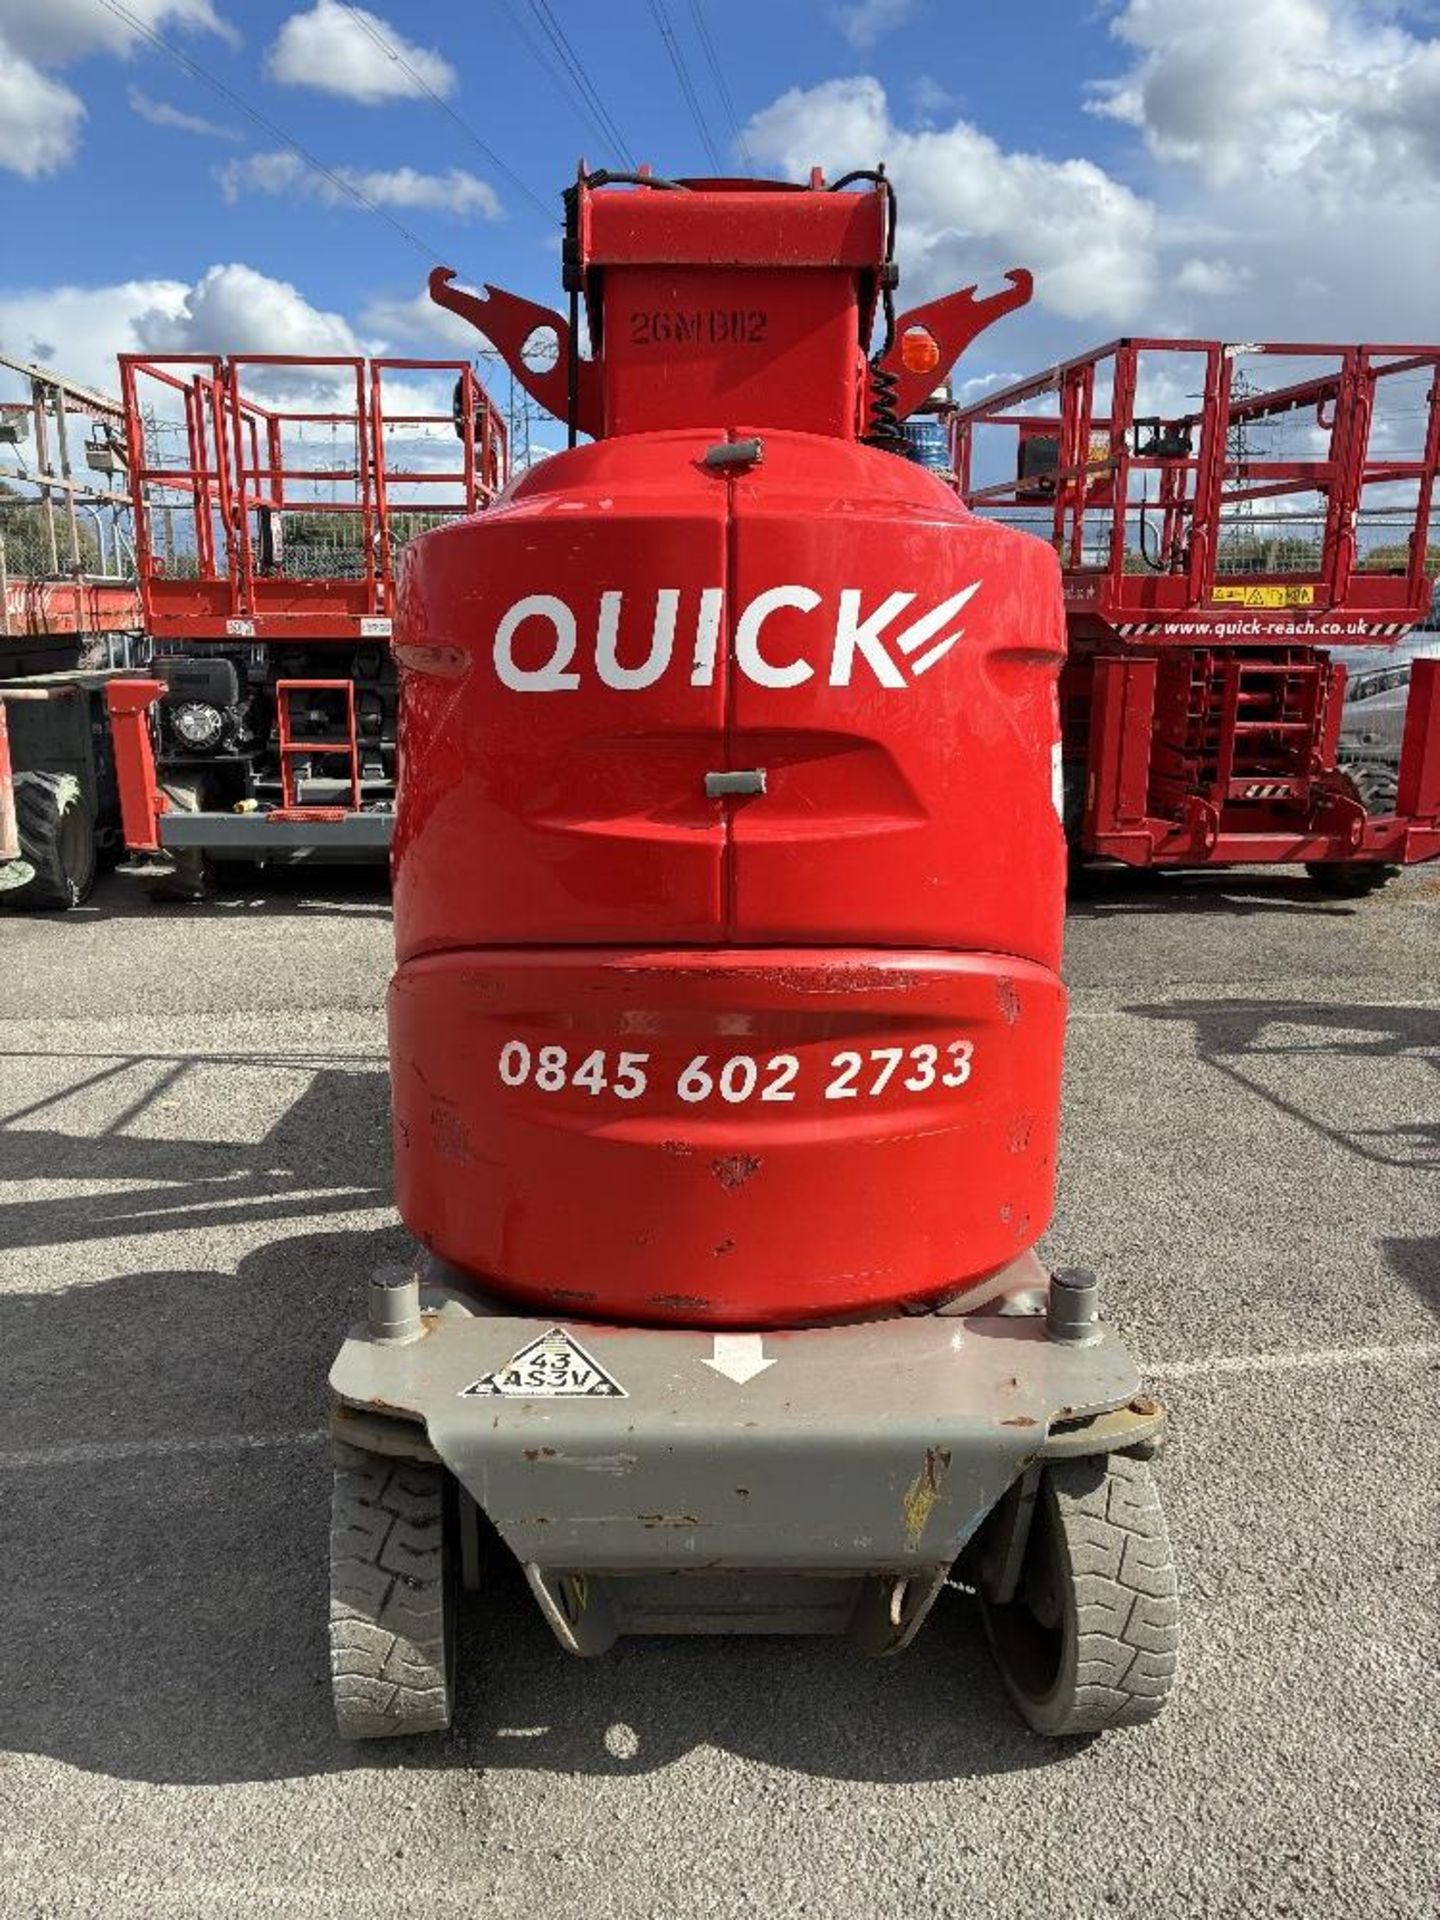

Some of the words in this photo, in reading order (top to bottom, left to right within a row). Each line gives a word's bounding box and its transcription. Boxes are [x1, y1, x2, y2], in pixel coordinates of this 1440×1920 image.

[493, 585, 918, 692] QUICK
[1164, 618, 1368, 637] www.quick-reach.co.uk
[499, 1041, 649, 1099] 0845
[677, 1055, 800, 1102] 602
[825, 1041, 974, 1099] 2733
[530, 1352, 572, 1370] 43
